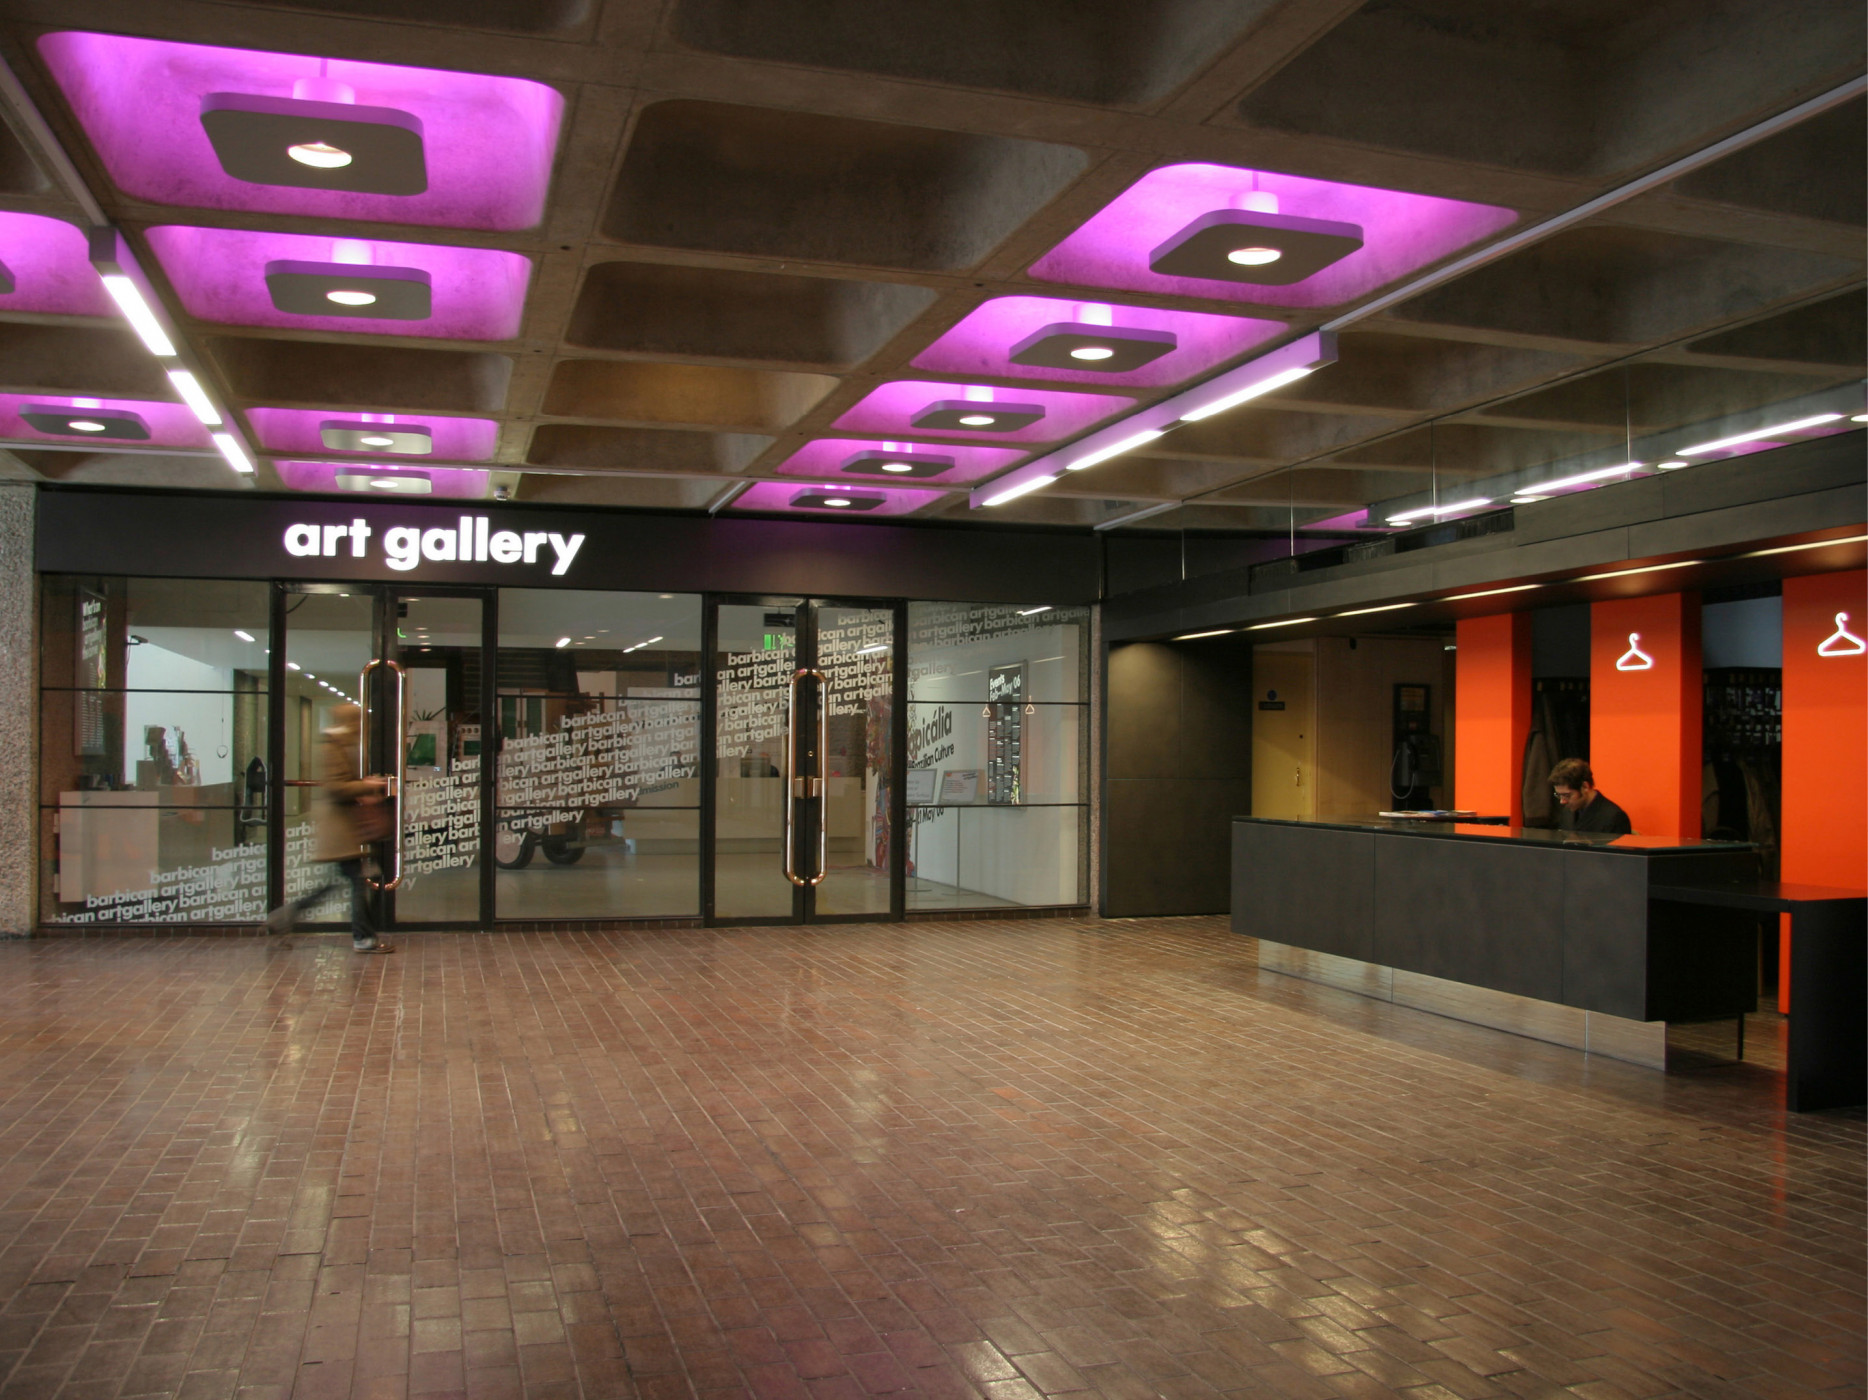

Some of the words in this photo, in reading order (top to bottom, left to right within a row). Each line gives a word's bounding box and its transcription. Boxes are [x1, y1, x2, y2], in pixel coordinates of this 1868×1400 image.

[284, 518, 371, 558] art
[384, 515, 585, 576] gallery
[919, 621, 983, 638] artgallery
[985, 614, 1039, 630] barbican
[934, 633, 990, 647] barbican
[728, 649, 789, 665] barbican
[820, 661, 886, 679] artgallery
[835, 673, 893, 690] barbican
[561, 706, 625, 728] barbican
[725, 714, 786, 731] barbican
[504, 732, 569, 750] barbican
[571, 720, 641, 740] artgallery
[514, 742, 587, 762] artgallery
[588, 734, 651, 751] barbican
[531, 755, 595, 773] barbican
[598, 743, 670, 763] artgallery
[541, 765, 614, 784] artgallery
[615, 756, 678, 773] barbican
[558, 777, 622, 796] barbican
[625, 766, 696, 785] artgallery
[568, 787, 640, 806] artgallery
[511, 810, 584, 829] artgallery
[149, 865, 219, 884] barbican
[86, 888, 158, 908] barbican
[161, 876, 239, 896] artgallery
[98, 898, 178, 920] artgallery
[179, 889, 249, 908] barbican
[190, 899, 267, 919] artgallery
